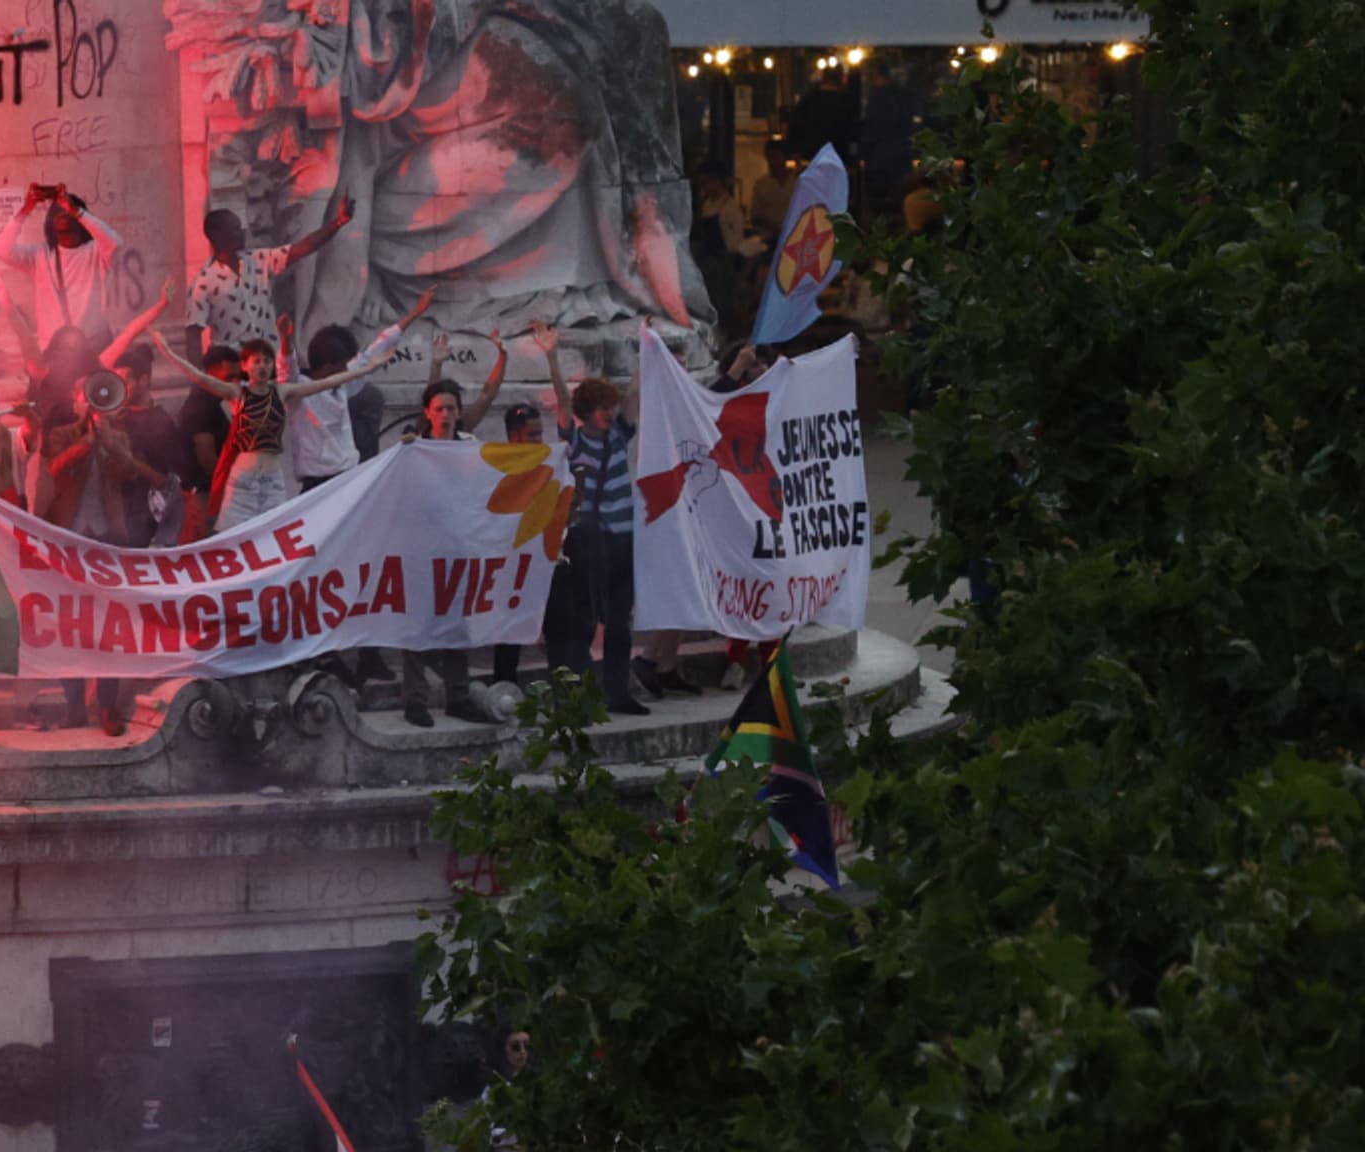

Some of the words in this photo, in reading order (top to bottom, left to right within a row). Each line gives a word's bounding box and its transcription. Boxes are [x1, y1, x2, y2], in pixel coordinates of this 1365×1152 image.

[54, 0, 119, 108] POP
[32, 115, 109, 160] FREE
[777, 409, 861, 467] JEUNESSE
[772, 465, 836, 511] CONTRE
[12, 519, 316, 587] ENSEMBLE
[753, 519, 786, 559] LE
[19, 567, 348, 654] CHANGEONS
[431, 555, 509, 618] VIE
